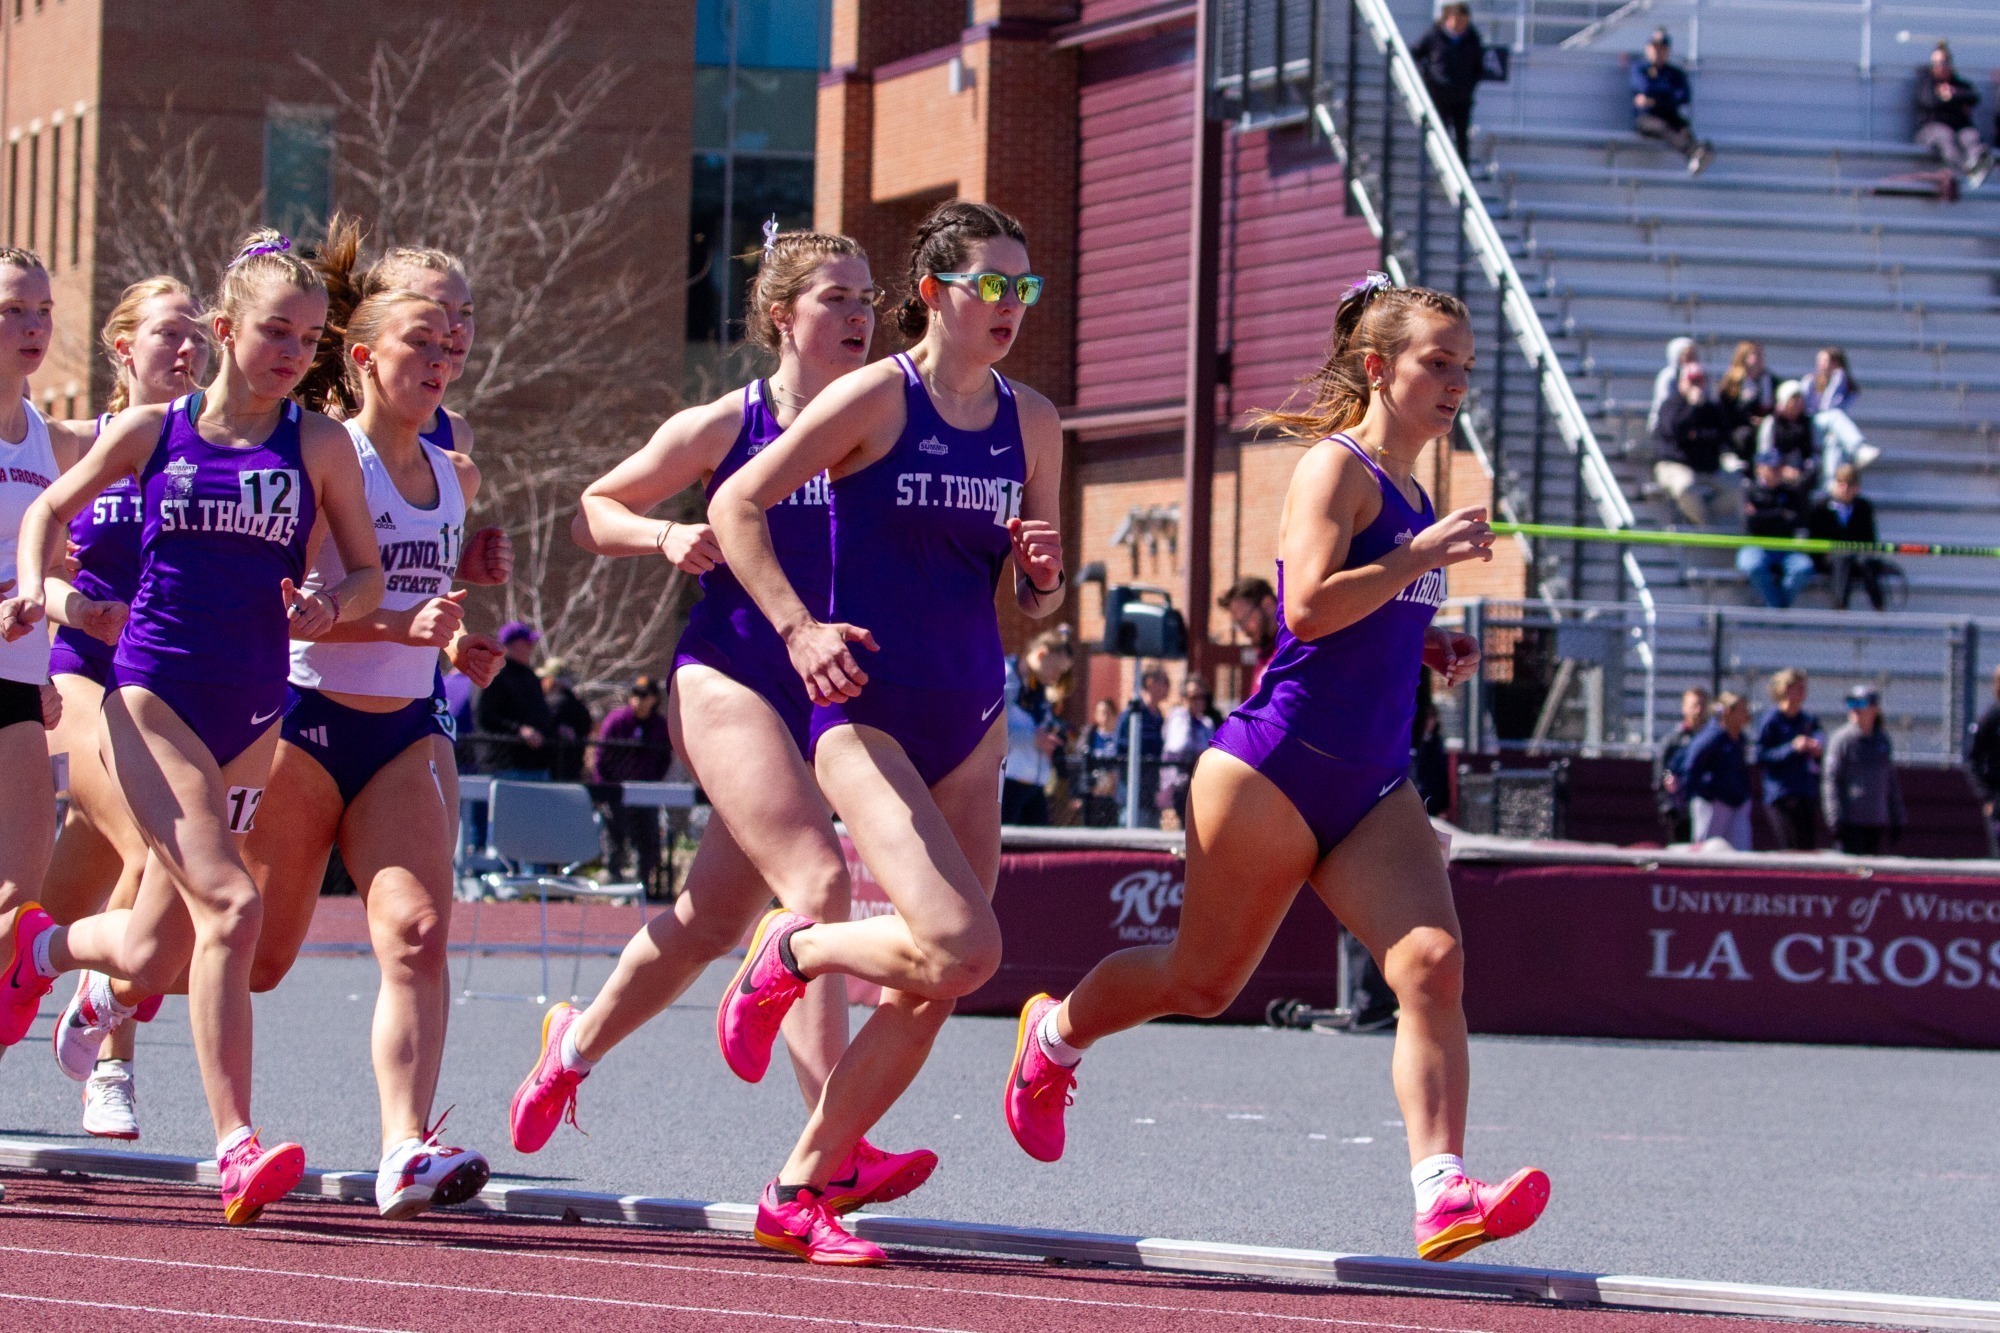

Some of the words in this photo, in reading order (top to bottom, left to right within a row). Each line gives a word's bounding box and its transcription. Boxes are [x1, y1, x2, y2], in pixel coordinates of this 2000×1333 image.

[9, 467, 53, 489] CROSS
[244, 471, 292, 514] 12
[386, 574, 442, 594] STATE
[1651, 884, 1839, 918] UNIVERSITY
[1850, 887, 1891, 934] of
[1898, 893, 2000, 924] WISCO
[1647, 929, 1752, 981] LA
